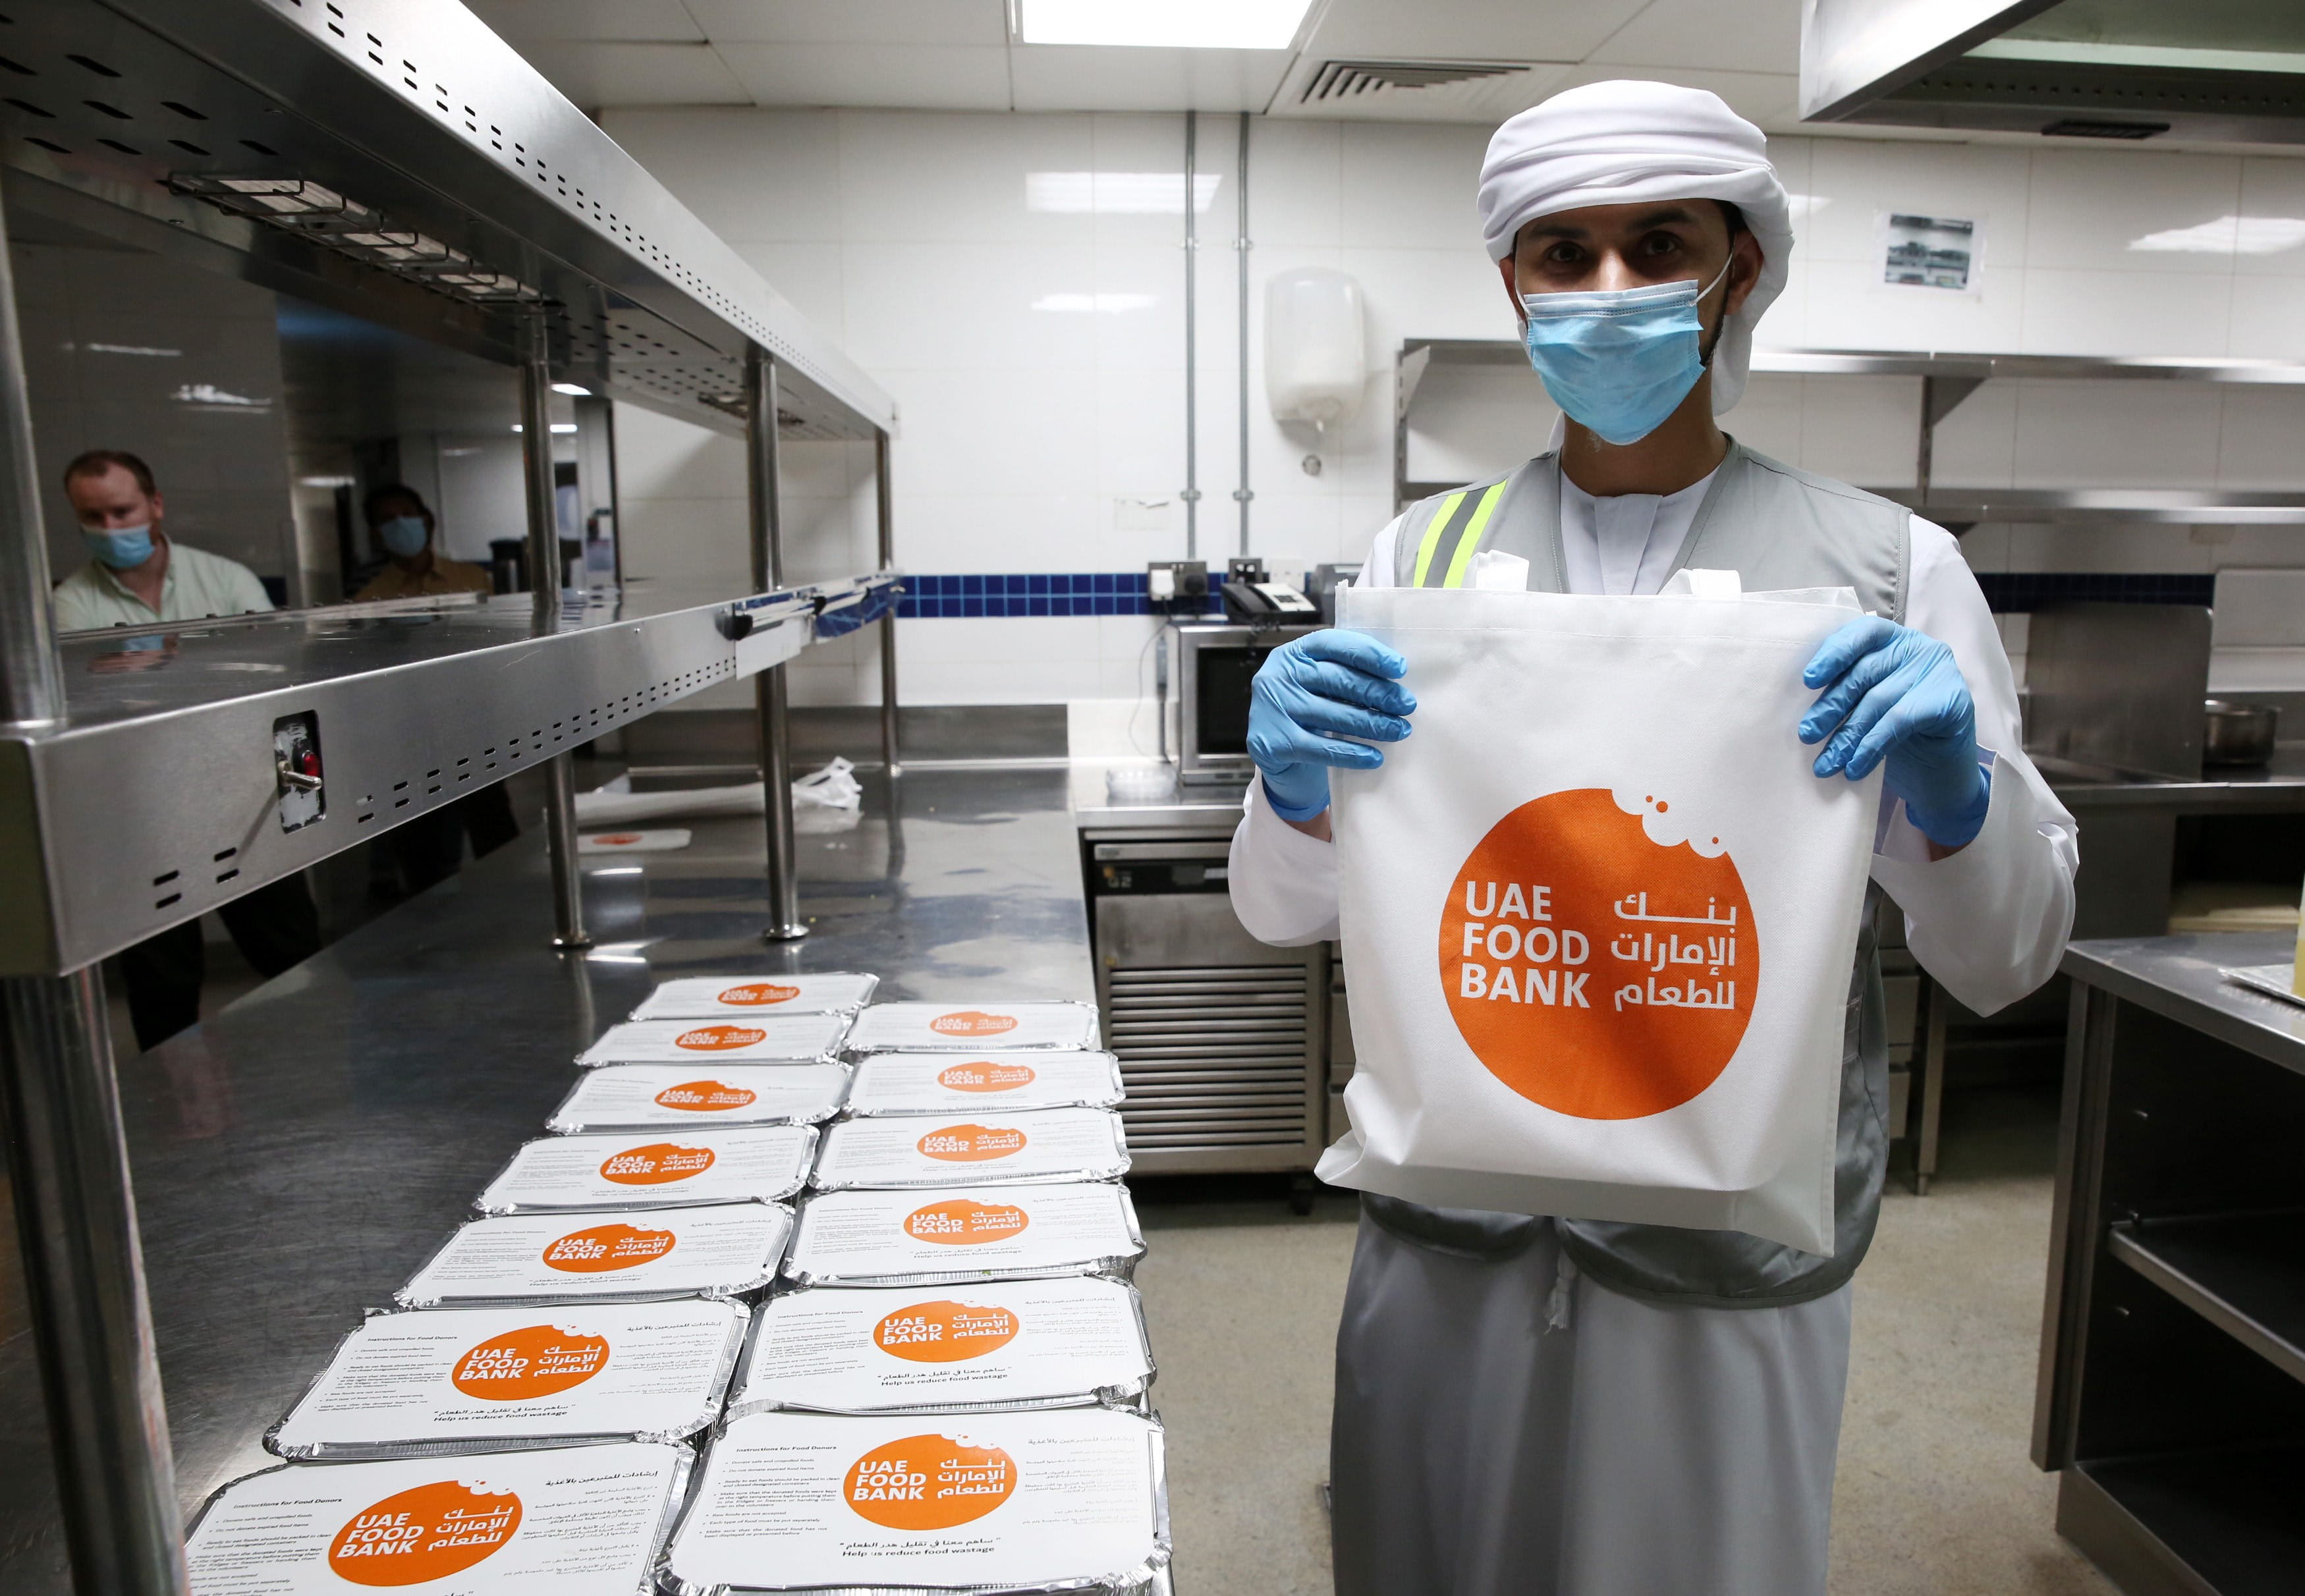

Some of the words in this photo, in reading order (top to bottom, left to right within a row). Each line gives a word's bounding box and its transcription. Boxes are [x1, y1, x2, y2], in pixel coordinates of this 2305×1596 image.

[1465, 881, 1552, 921] UAE
[1614, 892, 1736, 933] بنك
[1463, 922, 1590, 964] FOOD
[1611, 933, 1735, 975] الإمارات
[1460, 962, 1590, 1008] BANK
[1615, 977, 1735, 1011] للطعام
[912, 1219, 963, 1228] FOOD
[553, 1245, 607, 1253] FOOD
[884, 1323, 943, 1335] FOOD
[885, 1317, 925, 1327] UAE
[883, 1332, 943, 1345] BANK
[471, 1348, 516, 1360] UAE
[544, 1344, 602, 1354] بنك
[464, 1358, 529, 1370] FOOD
[538, 1352, 599, 1365] الإمارات
[458, 1368, 525, 1381] BANK
[534, 1363, 594, 1377] للطعام
[859, 1460, 908, 1473] UAE
[940, 1458, 1005, 1469] بنك
[856, 1473, 926, 1487] FOOD
[937, 1470, 1005, 1483] الإمارات
[853, 1487, 925, 1500] BANK
[937, 1483, 1004, 1499] للطعام
[443, 1505, 514, 1520] بنك
[356, 1512, 411, 1528] UAE
[435, 1515, 510, 1535] الإمارات
[346, 1526, 424, 1543] FOOD
[427, 1531, 502, 1551] للطعام
[336, 1540, 419, 1558] BANK
